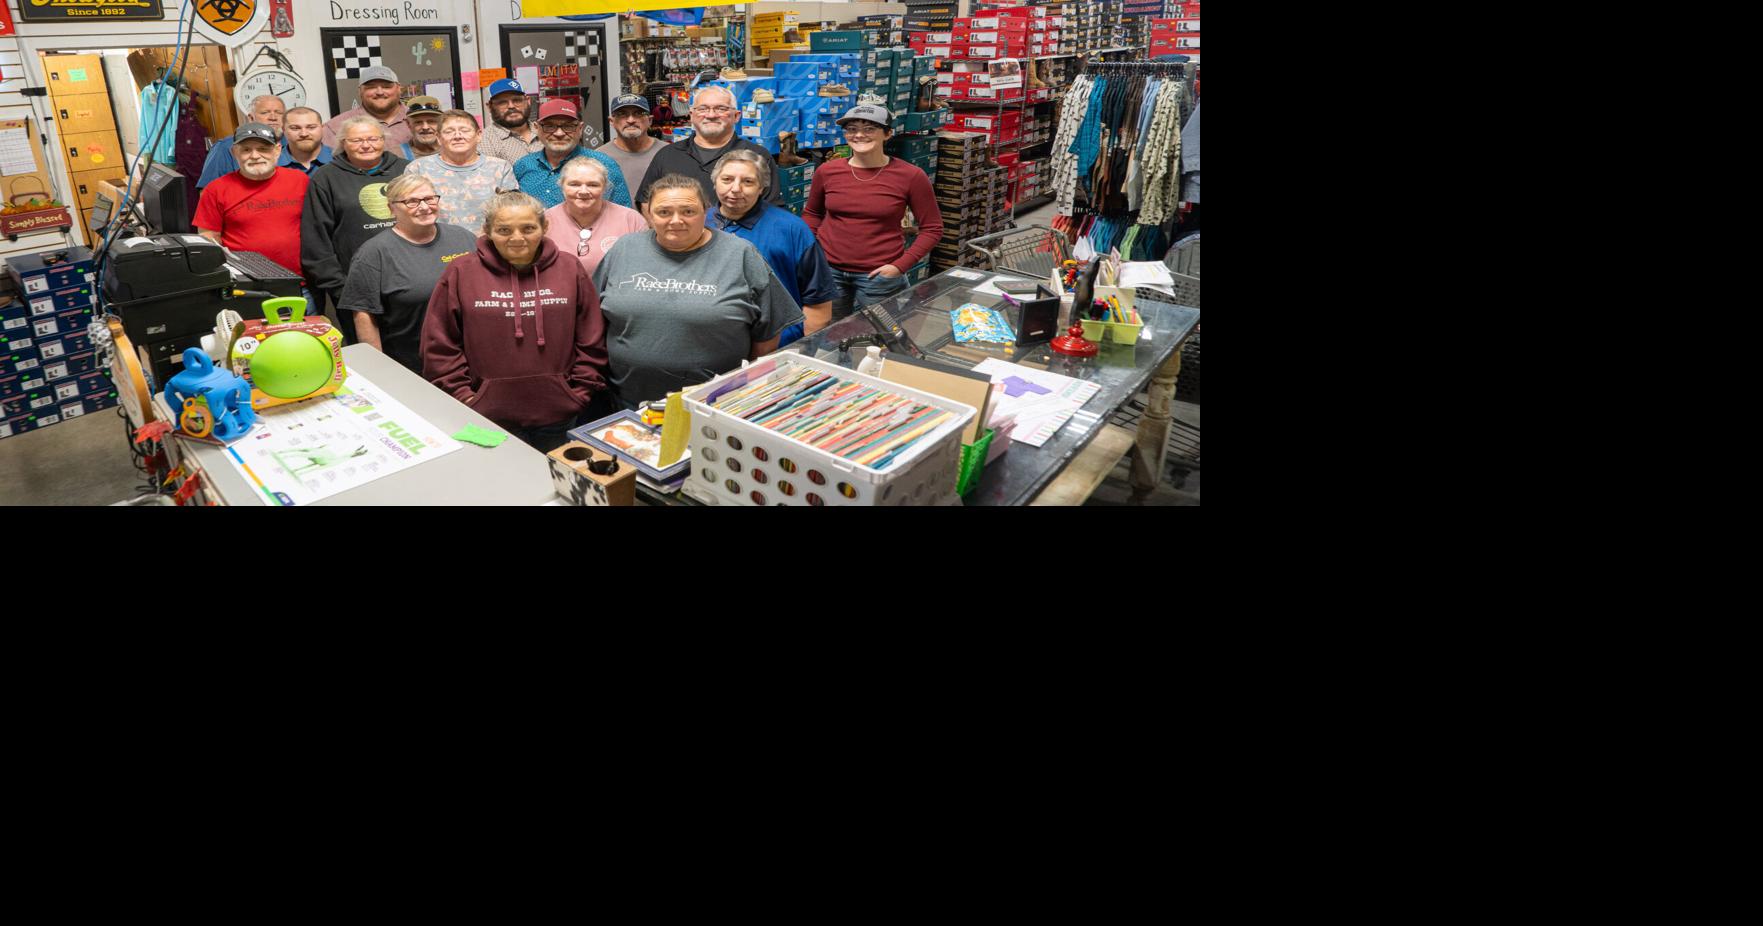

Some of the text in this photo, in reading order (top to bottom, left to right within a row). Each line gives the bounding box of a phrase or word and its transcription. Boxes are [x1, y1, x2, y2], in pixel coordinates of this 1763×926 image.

[66, 8, 98, 16] Since
[330, 0, 438, 25] Dressing Room
[363, 221, 398, 230] carhar
[636, 276, 717, 293] RaceBrothers
[490, 290, 514, 299] RAC
[327, 336, 341, 358] Jolly
[377, 420, 427, 455] FUEL
